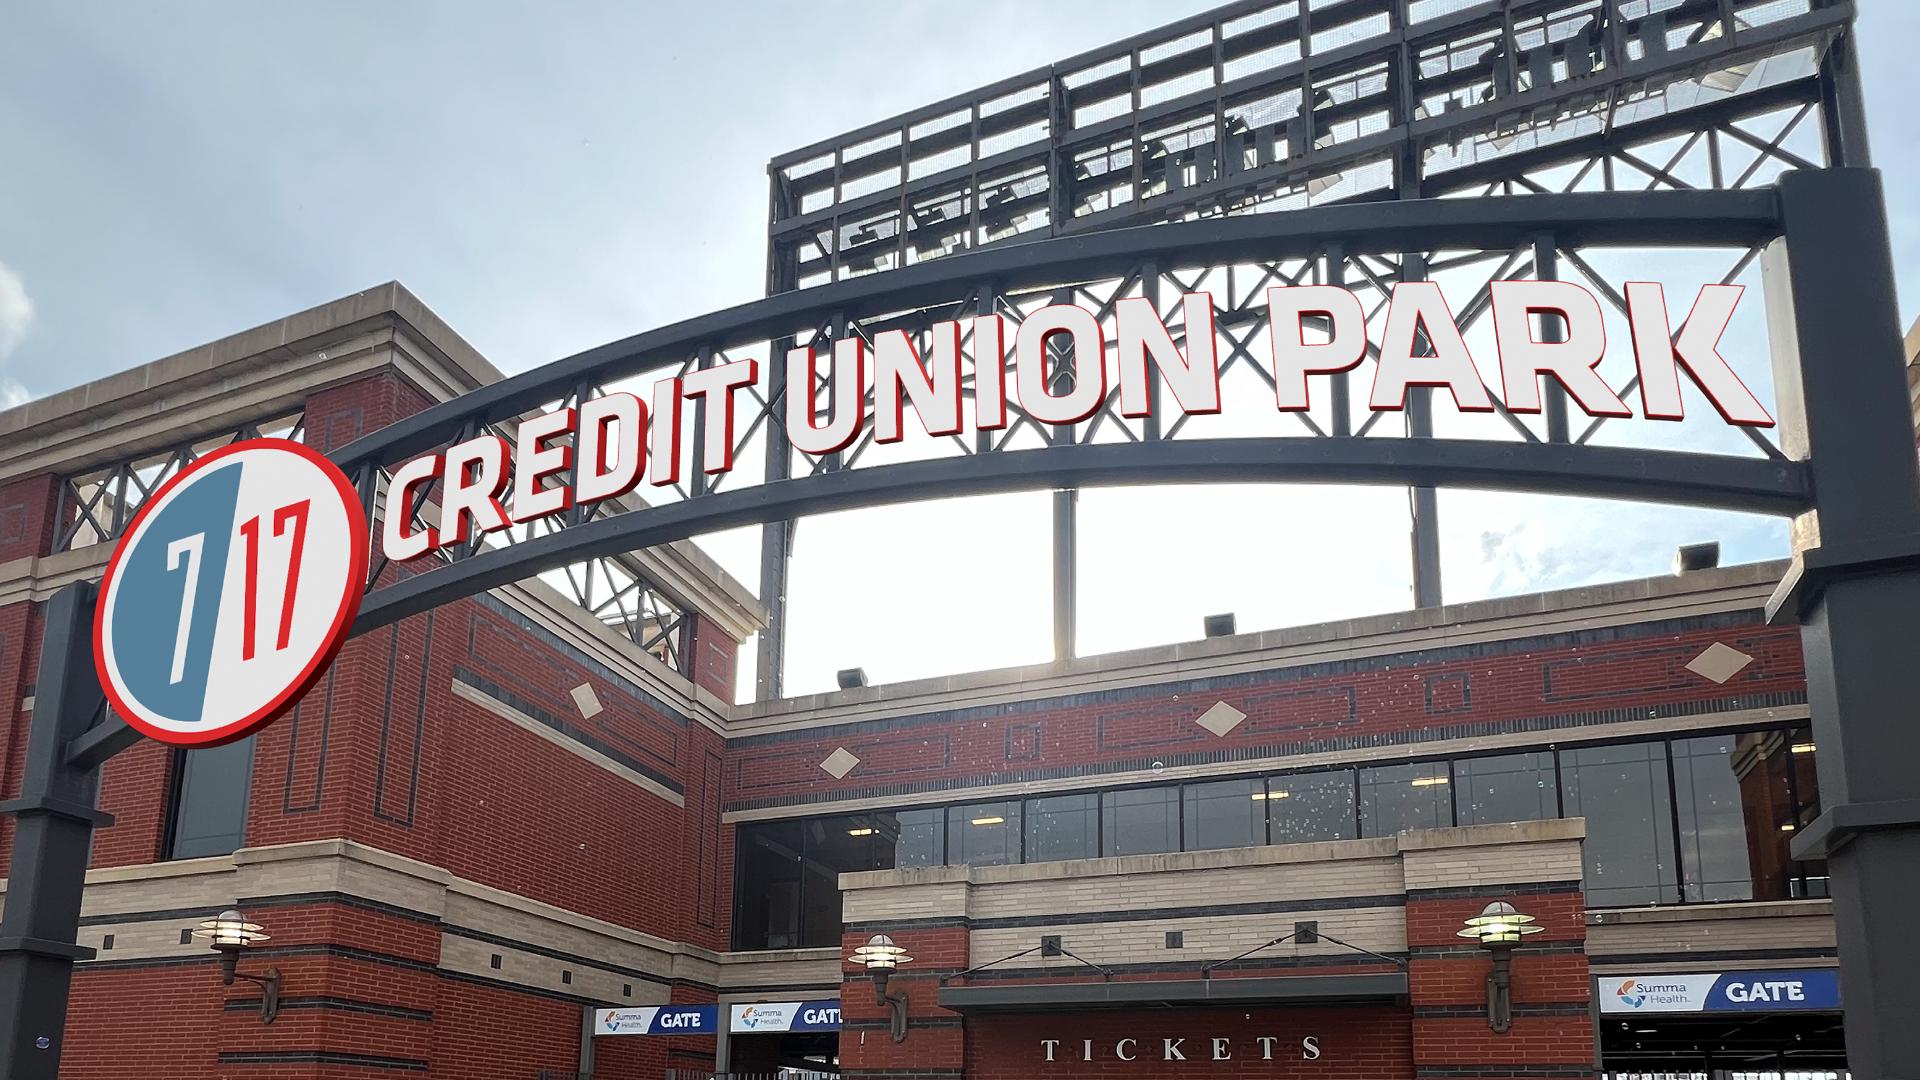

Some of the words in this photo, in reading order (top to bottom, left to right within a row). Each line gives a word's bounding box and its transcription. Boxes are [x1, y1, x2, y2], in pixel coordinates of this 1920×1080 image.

[382, 359, 758, 562] CREDIT
[786, 291, 1221, 455] UNION
[1267, 280, 1776, 428] PARK
[1636, 983, 1687, 993] Summa
[1725, 981, 1805, 1002] GATE
[615, 1013, 642, 1021] Summa
[660, 1012, 701, 1028] GATE
[752, 1008, 783, 1017] Summa
[1040, 1036, 1321, 1062] TICKETS
